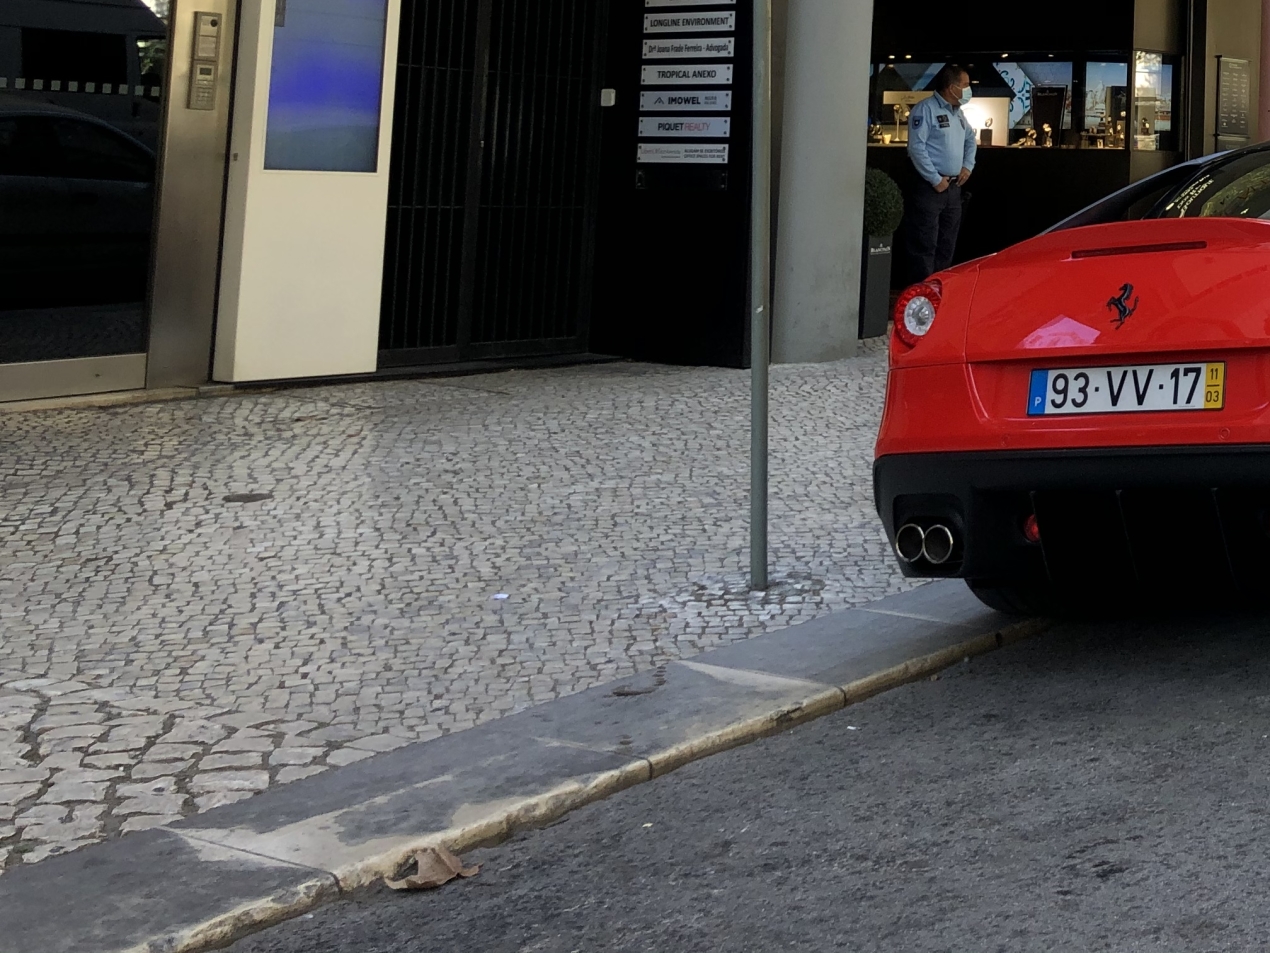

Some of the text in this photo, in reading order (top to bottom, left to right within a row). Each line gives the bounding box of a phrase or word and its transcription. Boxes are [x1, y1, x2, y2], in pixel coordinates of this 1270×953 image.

[650, 17, 729, 27] LONGLINE ENVIRONMENT
[657, 69, 717, 79] TROPICAL ANEXO
[667, 96, 701, 105] IMOWEL
[657, 122, 711, 131] PIQUET REALTY
[1209, 367, 1219, 381] 11
[1034, 396, 1042, 407] P
[1205, 390, 1220, 404] 03
